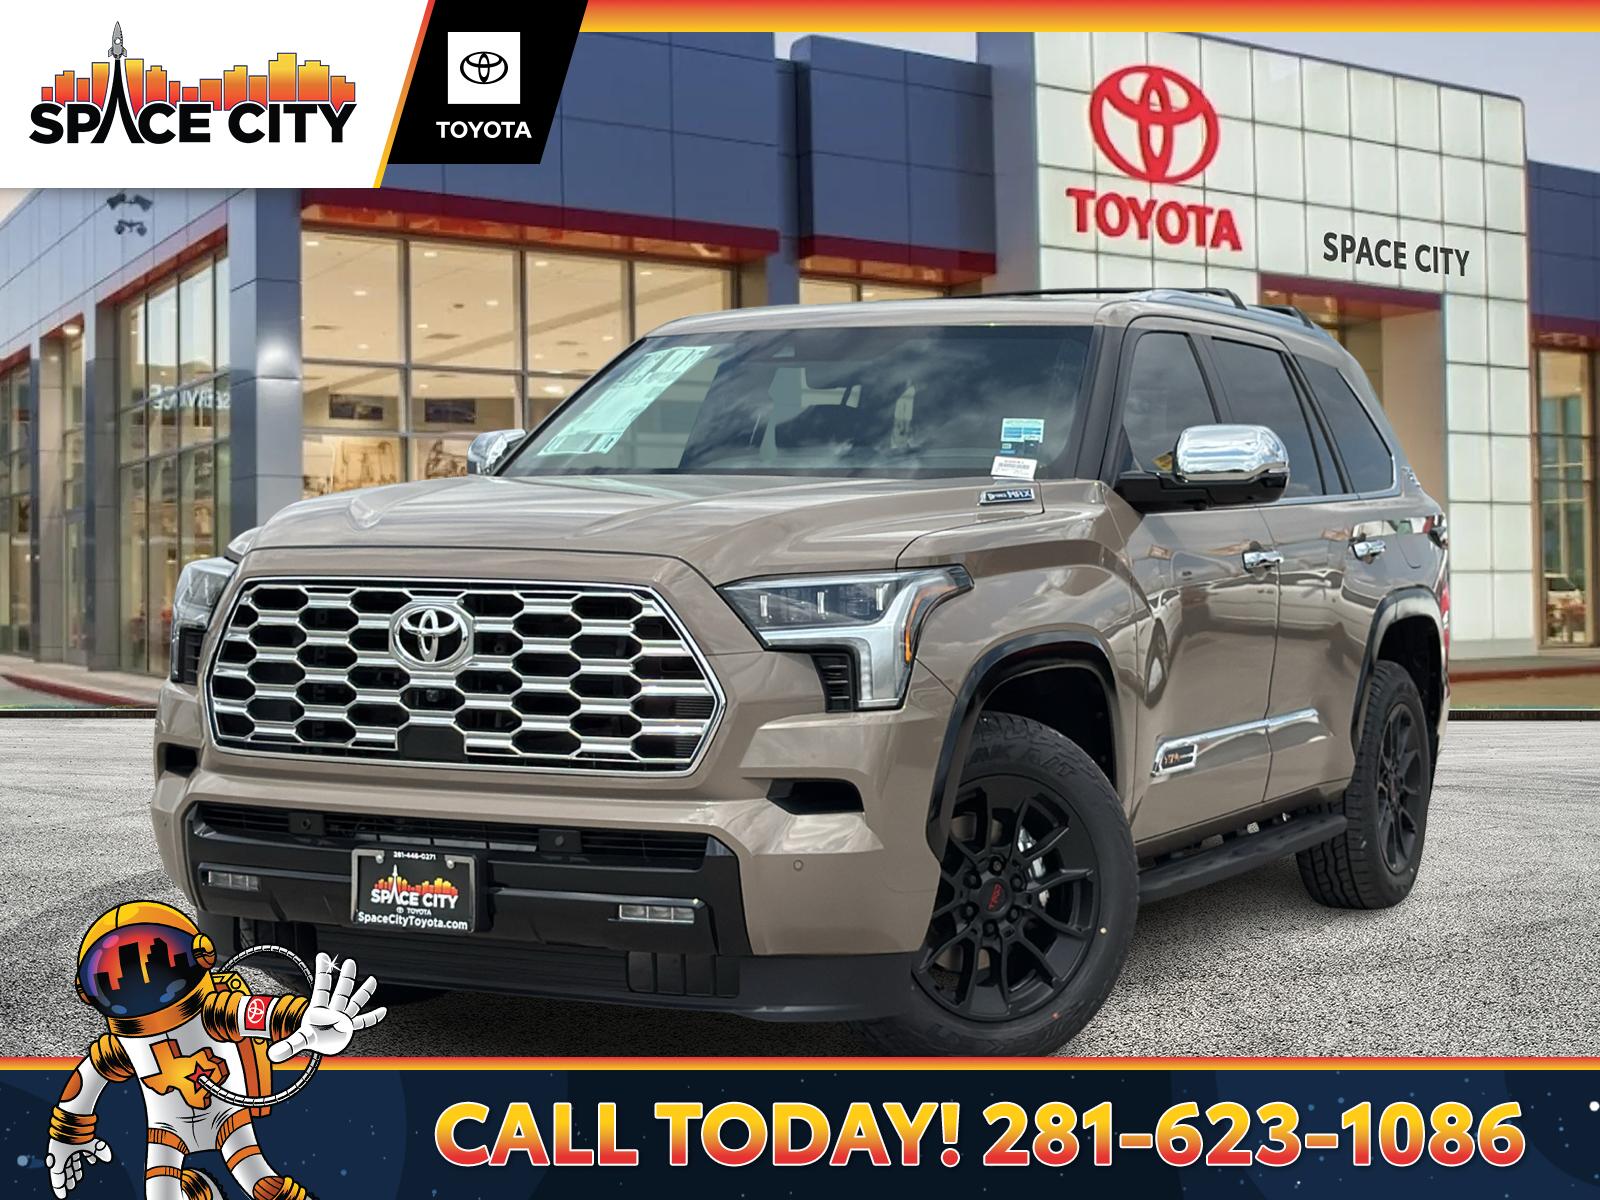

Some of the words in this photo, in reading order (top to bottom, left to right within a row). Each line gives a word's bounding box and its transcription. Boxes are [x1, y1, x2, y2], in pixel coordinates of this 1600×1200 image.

[1066, 187, 1243, 251] TOYOTA
[1323, 231, 1407, 270] SPACE
[1415, 243, 1470, 277] CITY
[371, 886, 419, 905] SPACE
[422, 892, 459, 909] CITY
[358, 911, 468, 931] SpaceCityToyota.com
[407, 907, 432, 916] TOYOTA
